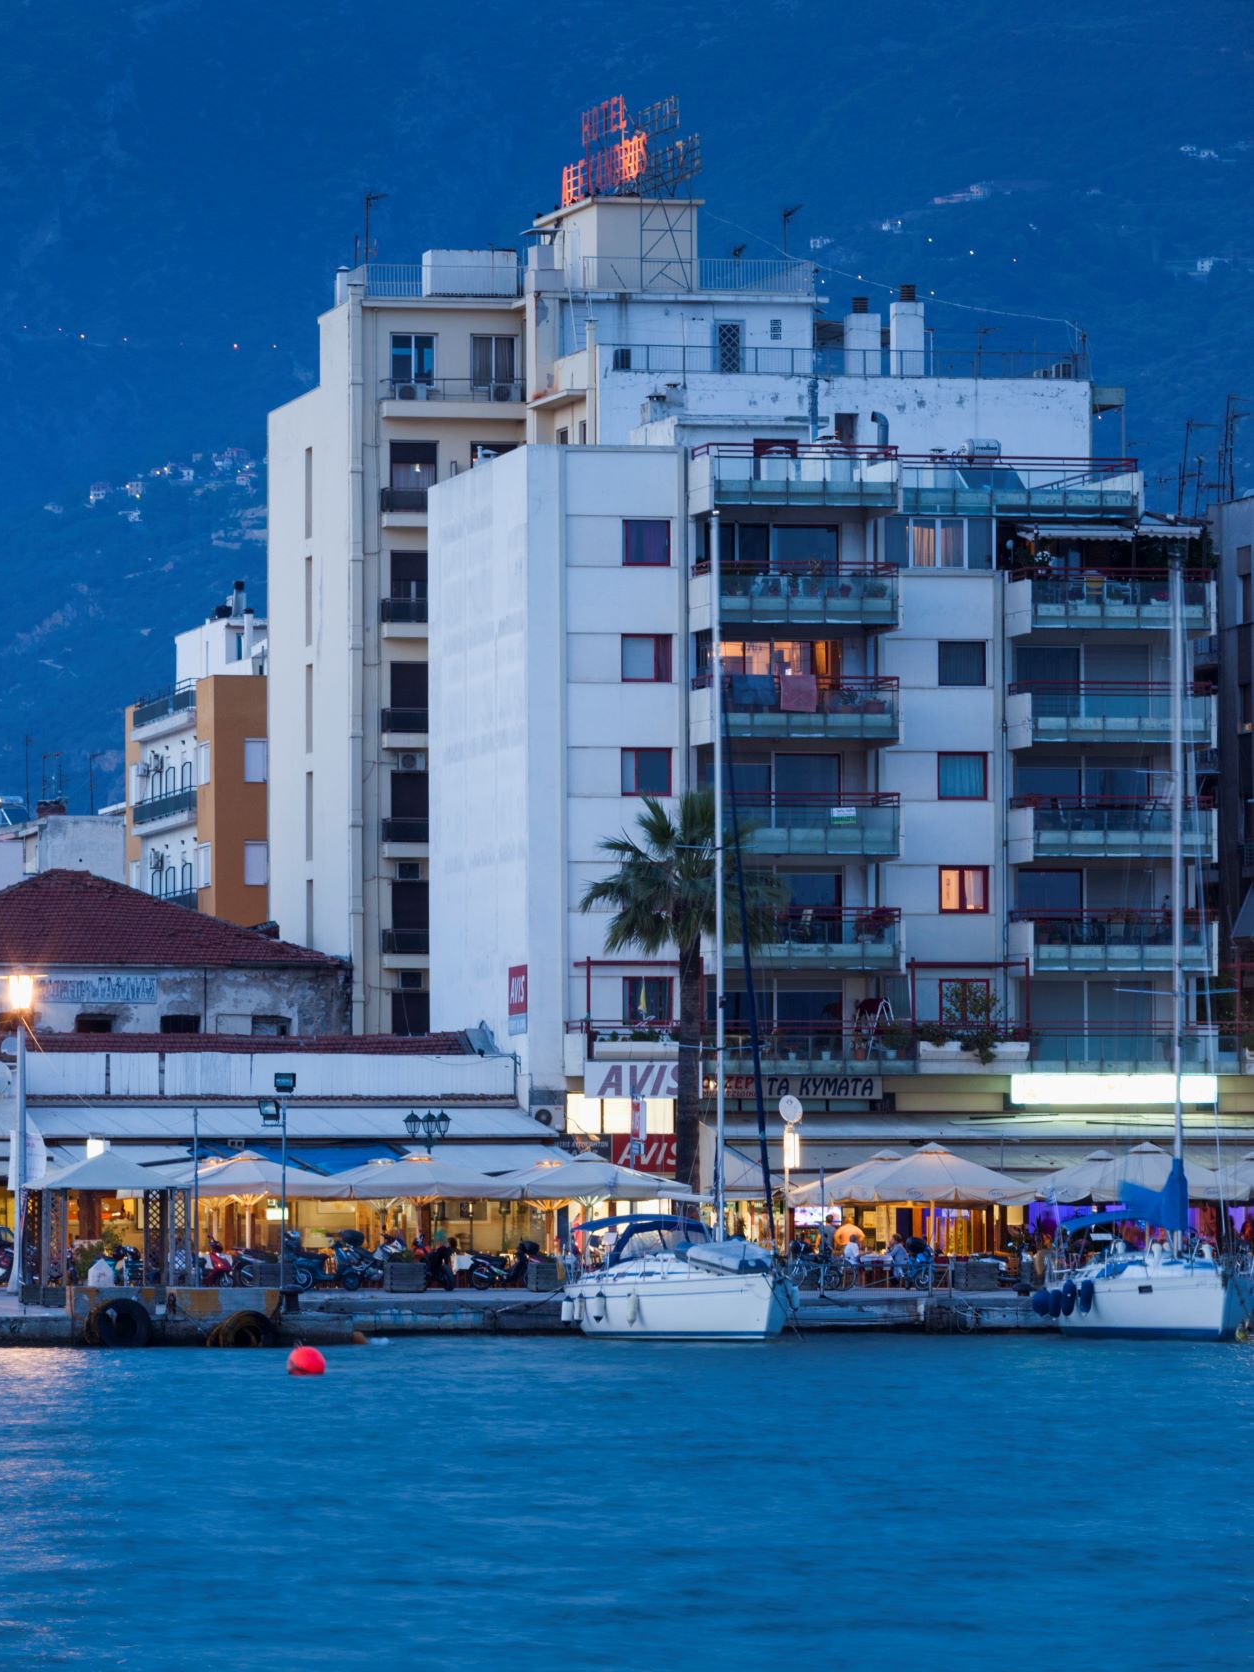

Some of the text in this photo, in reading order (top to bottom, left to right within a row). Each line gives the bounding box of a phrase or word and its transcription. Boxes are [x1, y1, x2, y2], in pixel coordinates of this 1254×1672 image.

[581, 94, 627, 147] HOTEL
[509, 974, 525, 1005] AVIS
[767, 1077, 790, 1096] ΤΑ
[799, 1077, 874, 1096] ΚΥΜΑΤΑ
